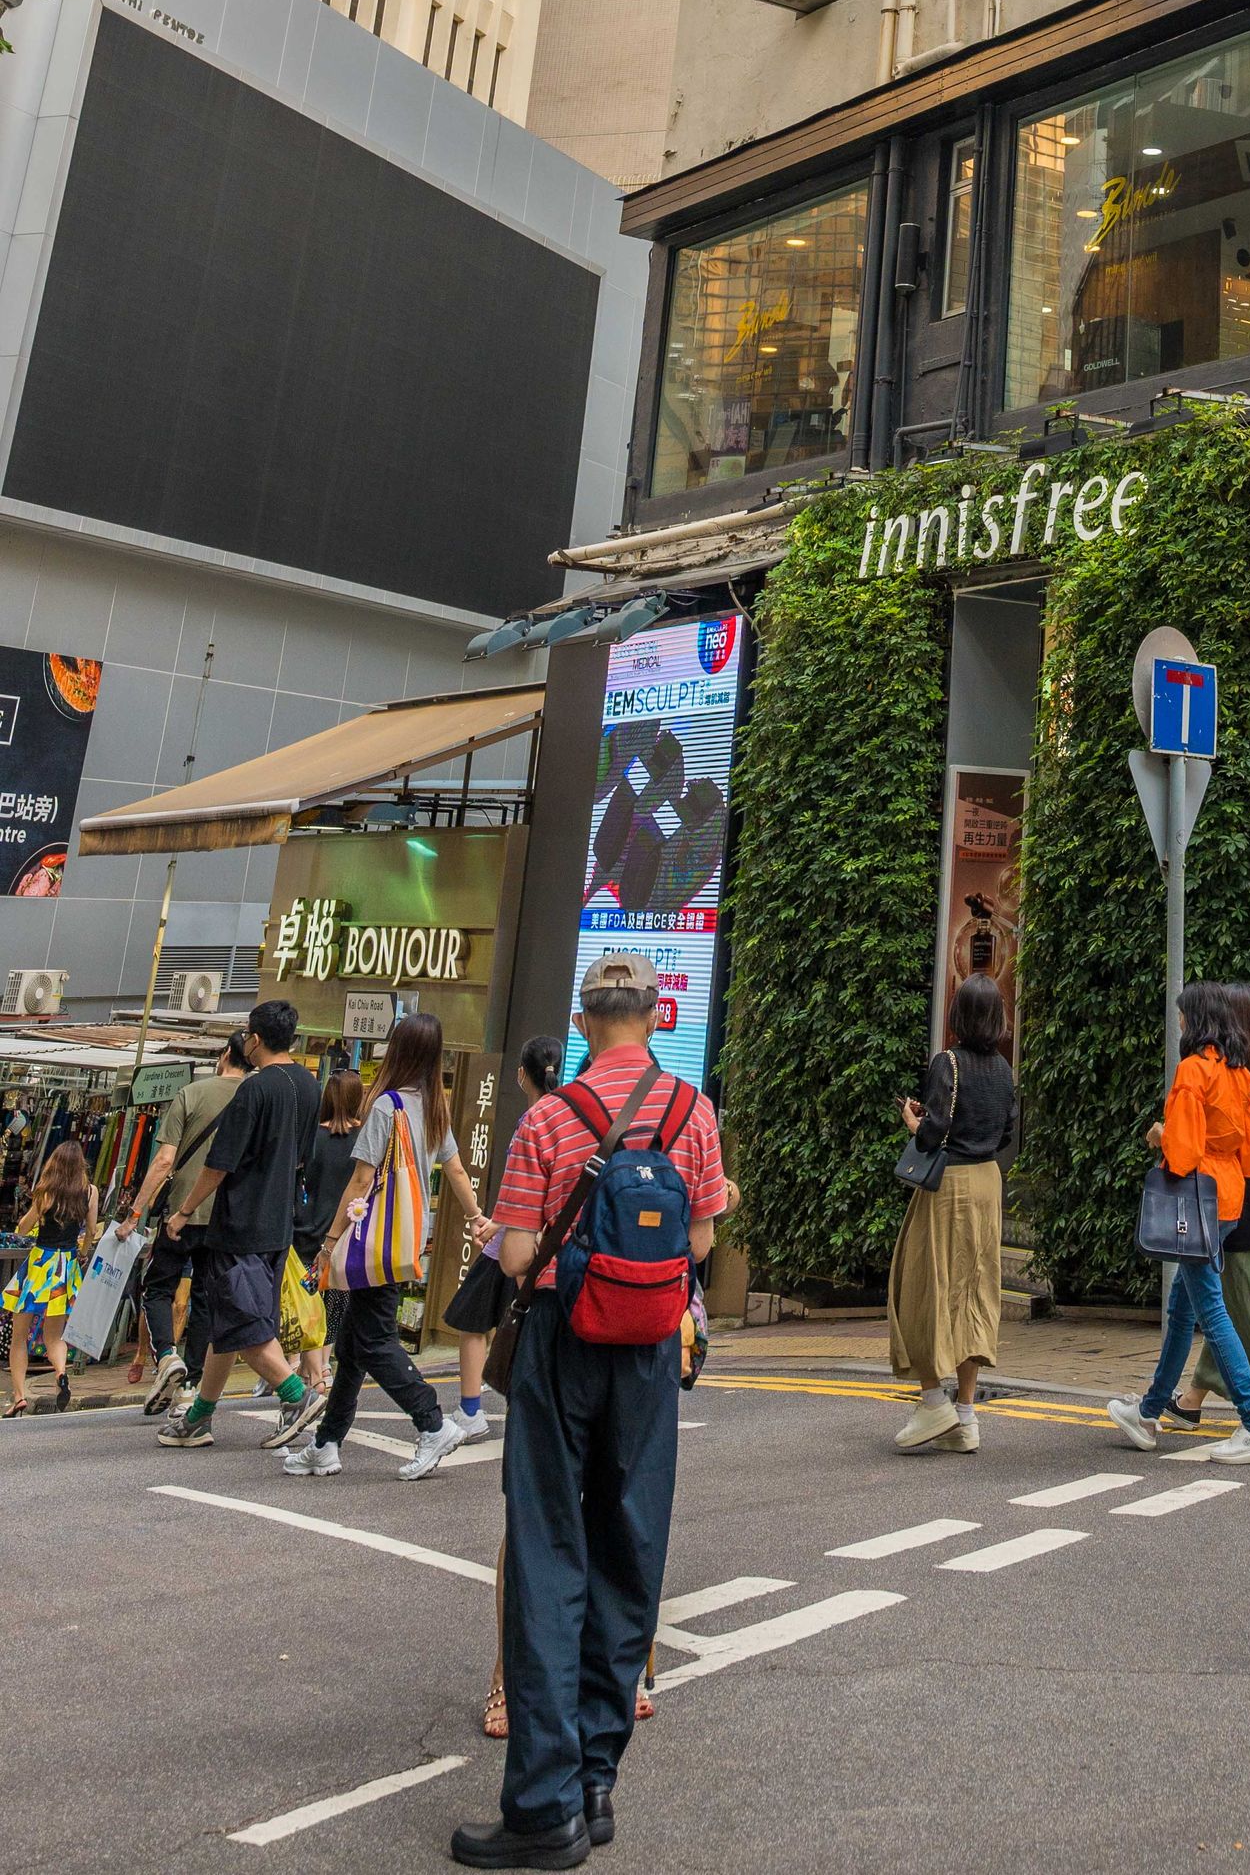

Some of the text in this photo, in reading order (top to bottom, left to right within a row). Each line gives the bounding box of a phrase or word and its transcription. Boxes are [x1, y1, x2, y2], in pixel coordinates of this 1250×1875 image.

[1084, 161, 1182, 253] Blonde
[1083, 357, 1120, 372] GOLDWELL
[858, 462, 1149, 579] innisfree
[704, 632, 728, 650] neo
[632, 656, 661, 671] MEDICAL
[612, 680, 700, 717] EMSCULPT
[963, 831, 1008, 847] 再生力量
[342, 926, 462, 987] BONJOUR
[348, 999, 384, 1012] Kai Chiu Road
[164, 1069, 185, 1080] Crescent
